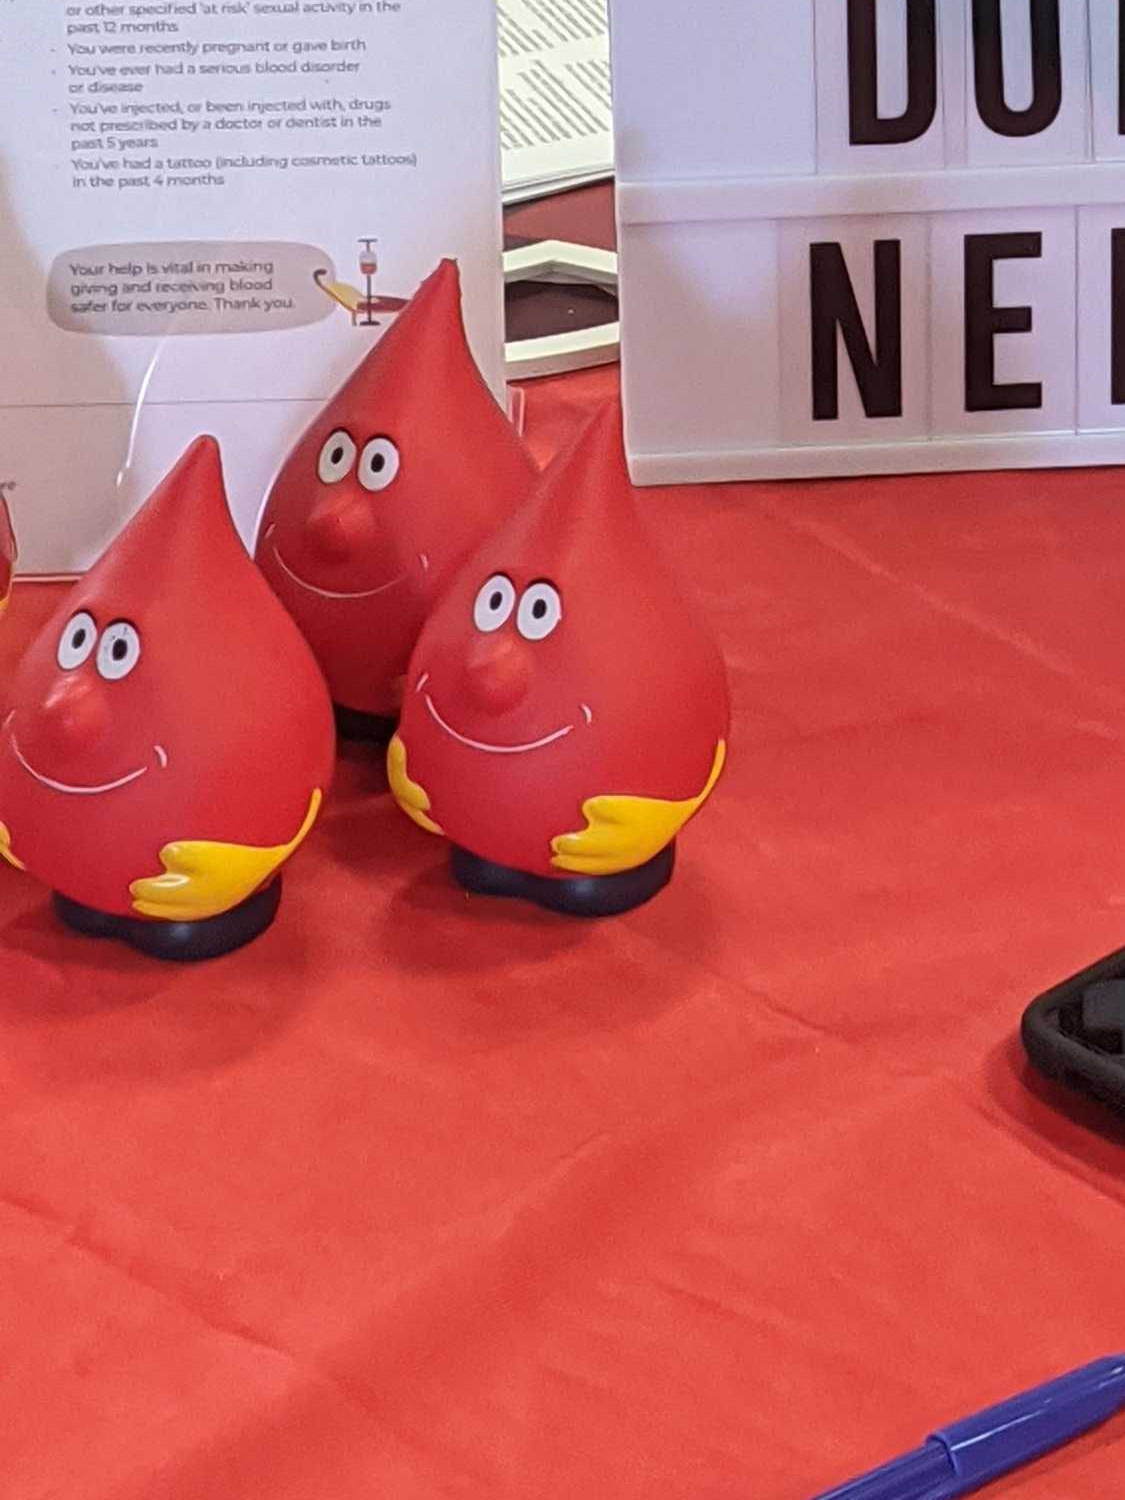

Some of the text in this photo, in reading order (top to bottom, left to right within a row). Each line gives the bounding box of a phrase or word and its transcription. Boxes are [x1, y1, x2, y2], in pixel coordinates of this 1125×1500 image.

[66, 6, 81, 16] or
[86, 3, 124, 16] other
[130, 3, 196, 17] specified
[254, 1, 299, 13] sexual
[303, 0, 355, 15] activity
[359, 0, 372, 12] in
[377, 0, 400, 12] the
[67, 21, 178, 35] past 12 months
[68, 39, 366, 55] You were recently pregnant or gave birth
[68, 60, 360, 76] You've ever had a serious blood disorder
[69, 82, 143, 93] or disease
[70, 103, 117, 114] You've
[187, 103, 201, 113] or
[206, 101, 243, 112] been
[248, 99, 306, 113] injected
[349, 98, 391, 112] drugs
[70, 116, 382, 133] not prescribed by a doctor or dentist in the
[71, 137, 158, 151] past 5 years
[72, 158, 118, 170] You've
[123, 156, 151, 169] had
[155, 160, 163, 169] a
[167, 157, 212, 169] tattoo
[216, 156, 288, 169] (including
[292, 155, 357, 166] cosmetic
[73, 173, 225, 189] in the past 4 months
[69, 260, 273, 277] Your help is vital in making
[71, 278, 272, 296] giving and receiving blood
[71, 300, 107, 314] safer
[112, 300, 133, 312] for
[214, 297, 260, 310] Thank
